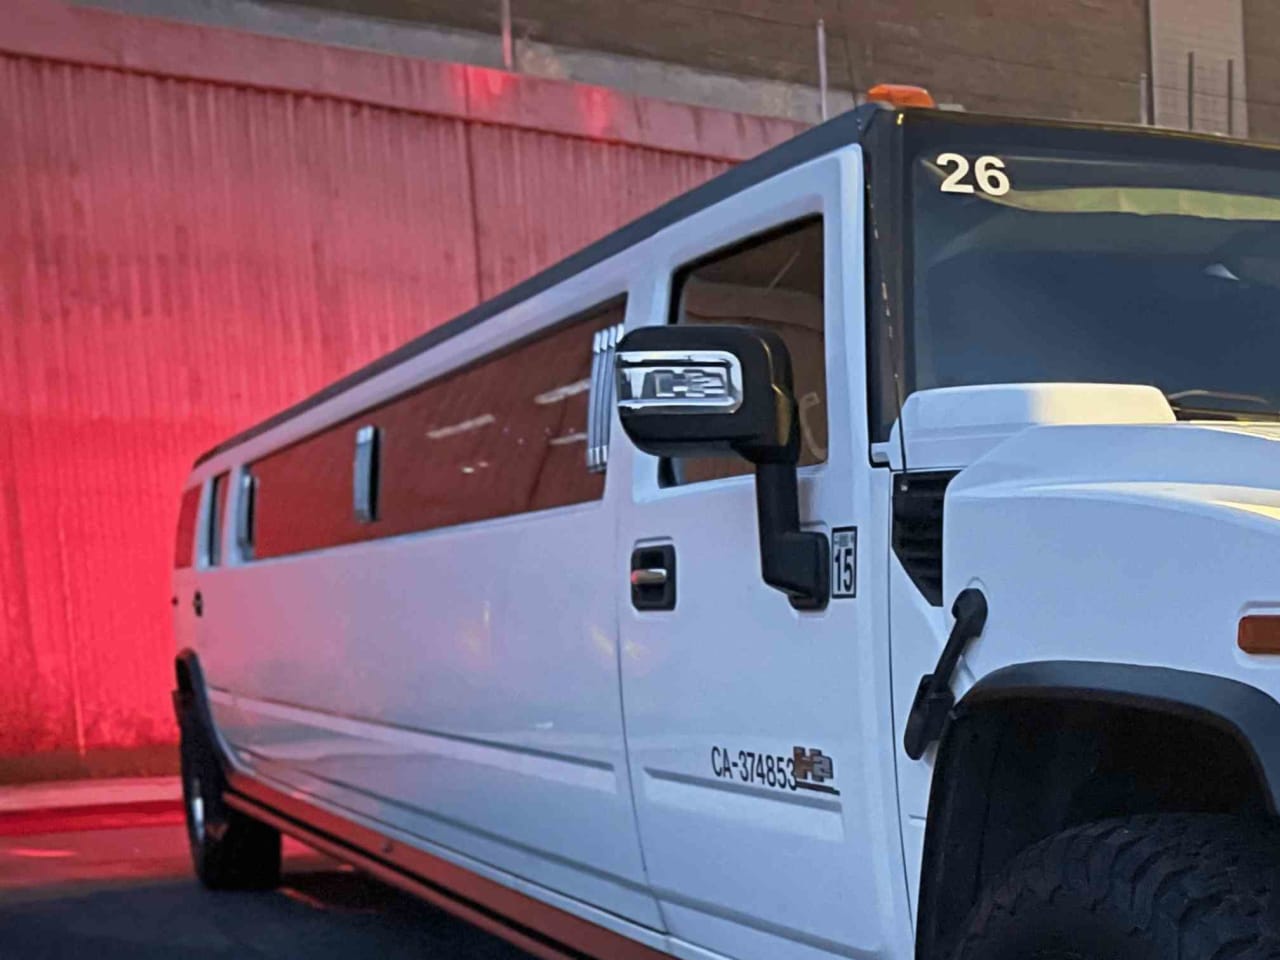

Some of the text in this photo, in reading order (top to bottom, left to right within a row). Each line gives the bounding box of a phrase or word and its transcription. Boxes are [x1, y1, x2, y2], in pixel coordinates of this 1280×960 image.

[936, 152, 1010, 196] 26
[834, 548, 853, 593] 15
[711, 746, 798, 791] CA-374853
